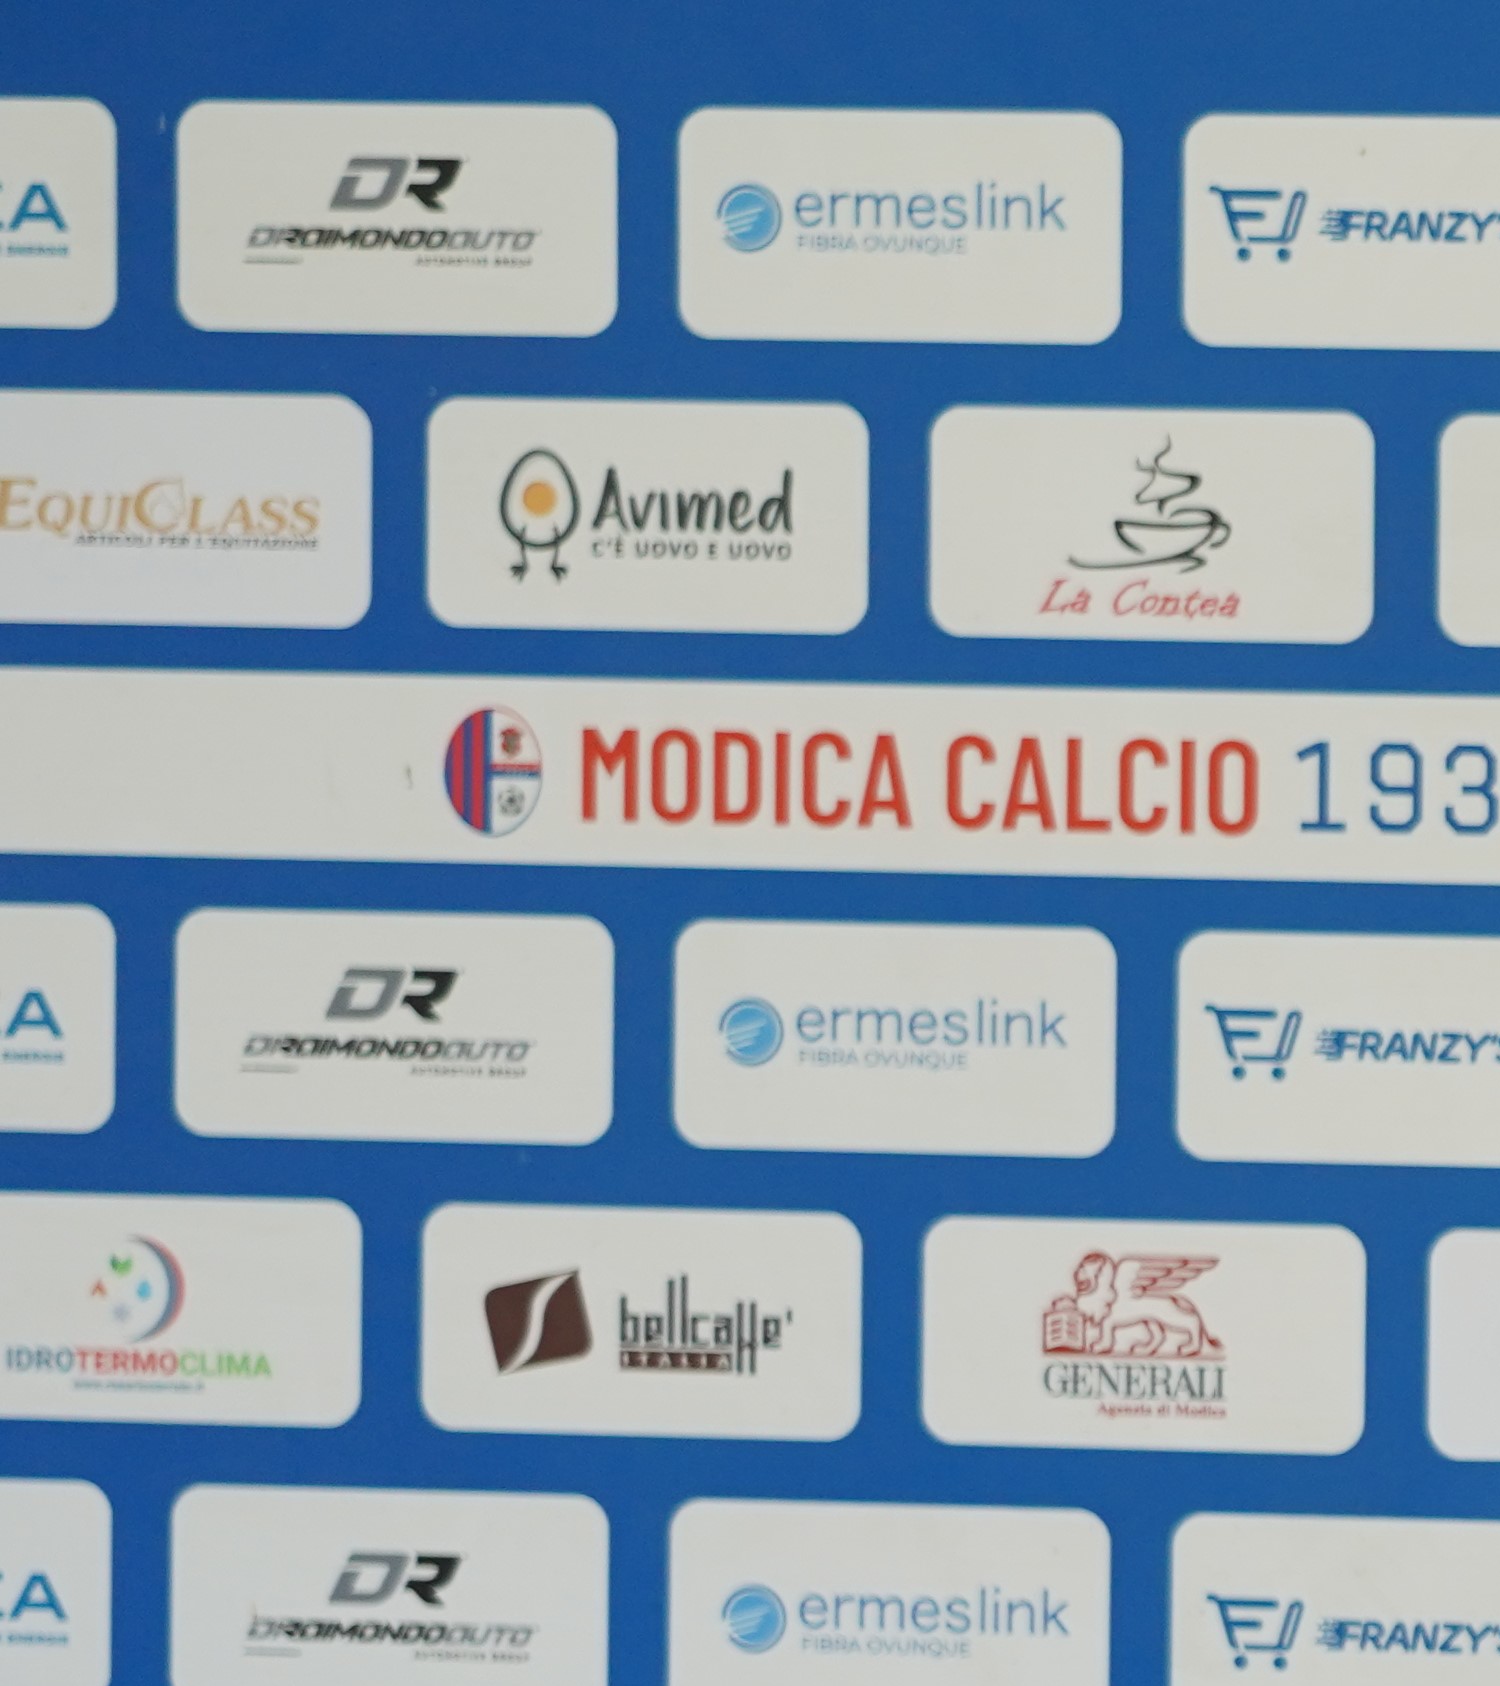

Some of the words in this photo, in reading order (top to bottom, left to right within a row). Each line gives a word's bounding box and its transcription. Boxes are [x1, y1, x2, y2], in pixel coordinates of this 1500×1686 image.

[792, 181, 1066, 232] ermeslink
[591, 466, 793, 534] Avimed
[1038, 577, 1093, 615] La
[581, 727, 912, 829] MODICA
[945, 733, 1259, 837] CALCIO
[794, 997, 1067, 1048] ermeslink
[1042, 1362, 1225, 1402] GENERALI
[796, 1586, 1070, 1636] ermeslink
